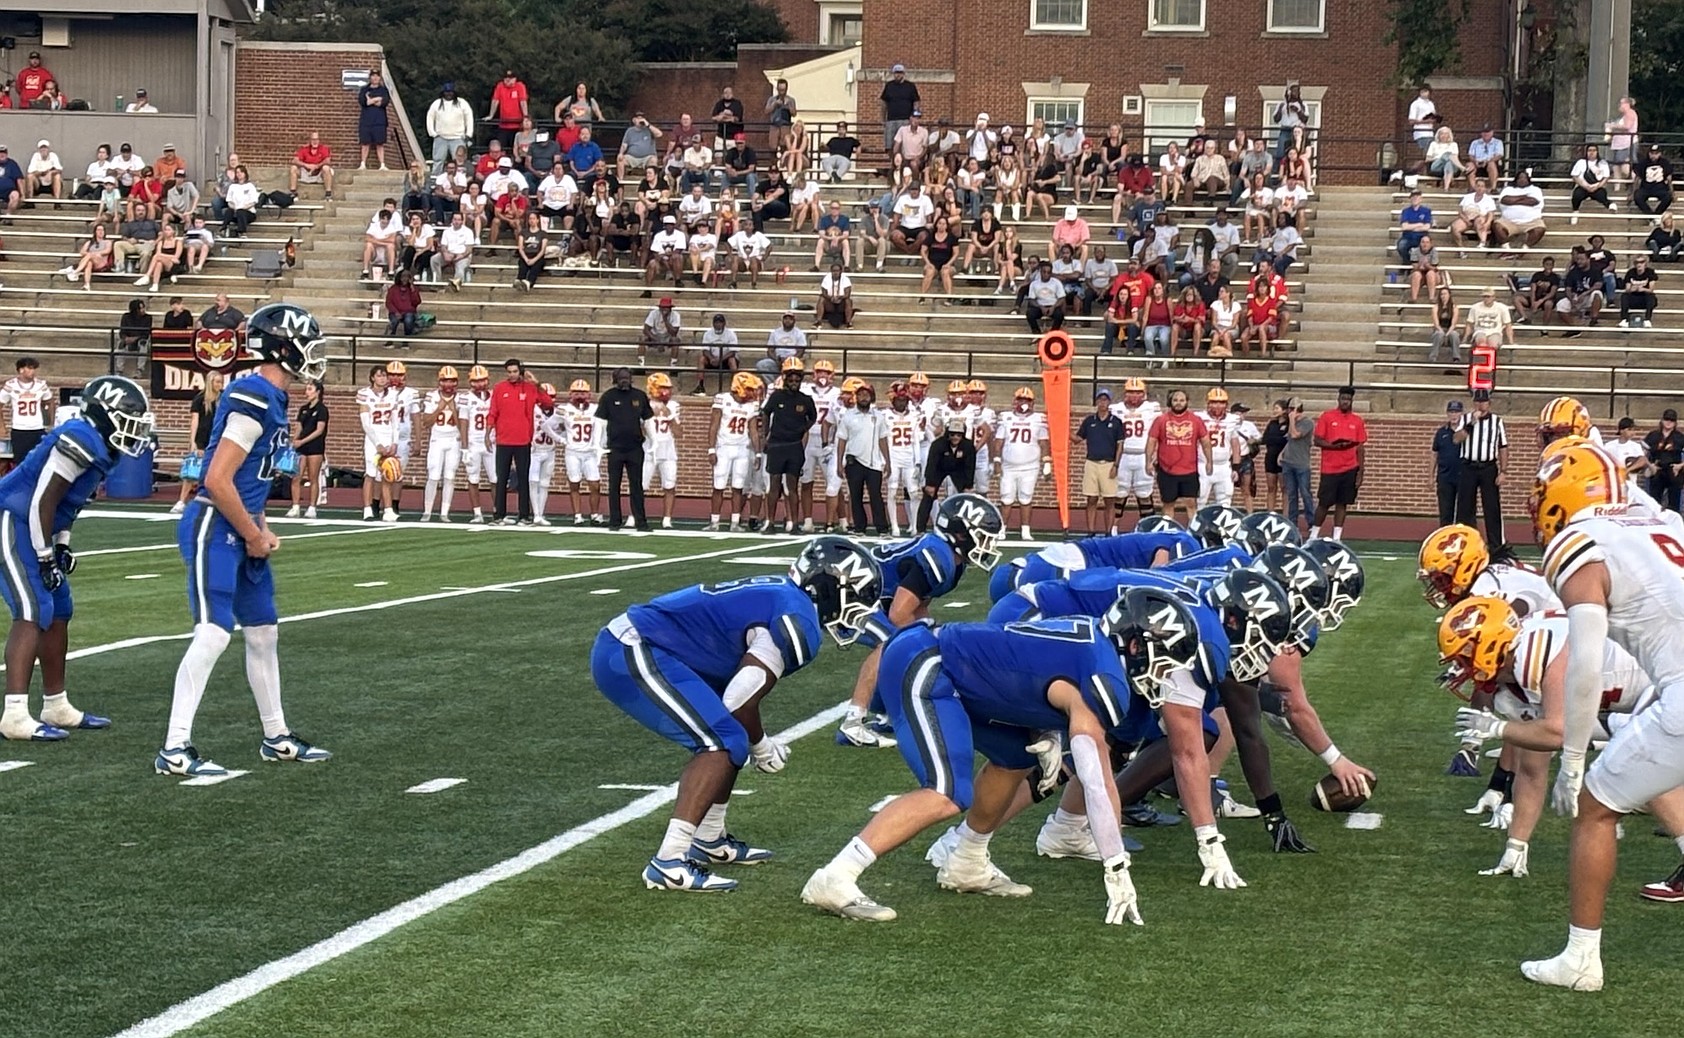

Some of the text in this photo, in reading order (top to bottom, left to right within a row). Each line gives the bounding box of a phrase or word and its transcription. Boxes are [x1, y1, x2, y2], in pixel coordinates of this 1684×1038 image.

[280, 310, 313, 337] M
[1469, 346, 1496, 389] 2
[94, 381, 126, 408] M
[17, 400, 37, 416] 20
[571, 423, 593, 442] 39
[728, 416, 747, 435] 48
[892, 428, 912, 447] 25
[1010, 428, 1033, 444] 70
[1123, 420, 1145, 438] 68
[1209, 430, 1226, 448] 51
[957, 501, 986, 527] M
[1213, 509, 1241, 538] M
[1256, 516, 1291, 541] M
[832, 551, 875, 594] M
[1280, 556, 1318, 591] M
[1327, 550, 1359, 582] M
[1241, 583, 1281, 622] M
[1148, 604, 1187, 650] M
